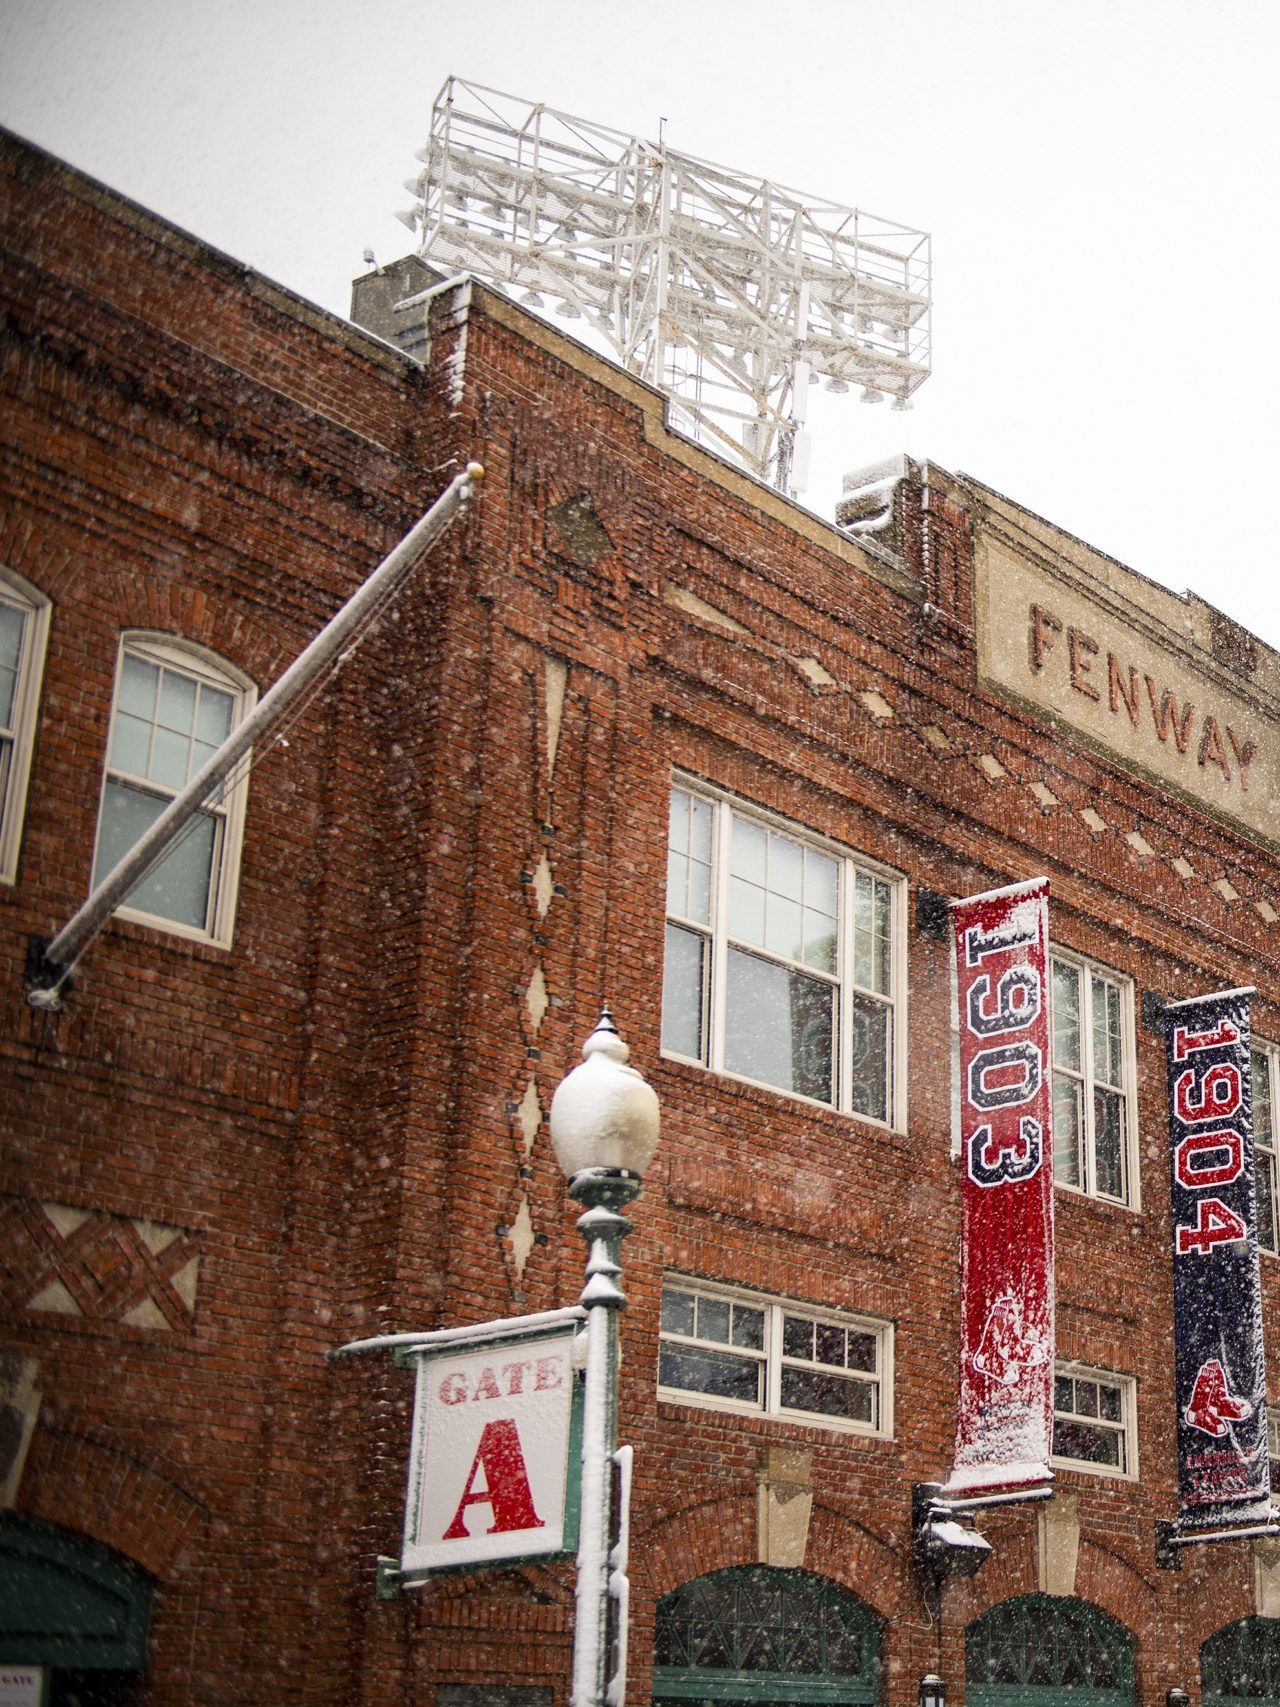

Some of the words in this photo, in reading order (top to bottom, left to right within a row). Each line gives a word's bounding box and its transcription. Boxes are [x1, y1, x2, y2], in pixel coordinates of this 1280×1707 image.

[1029, 603, 1257, 791] FENWAY
[964, 922, 1044, 1188] 1903
[1173, 1018, 1248, 1257] 1904
[439, 1355, 564, 1406] GATE
[441, 1417, 546, 1541] A
